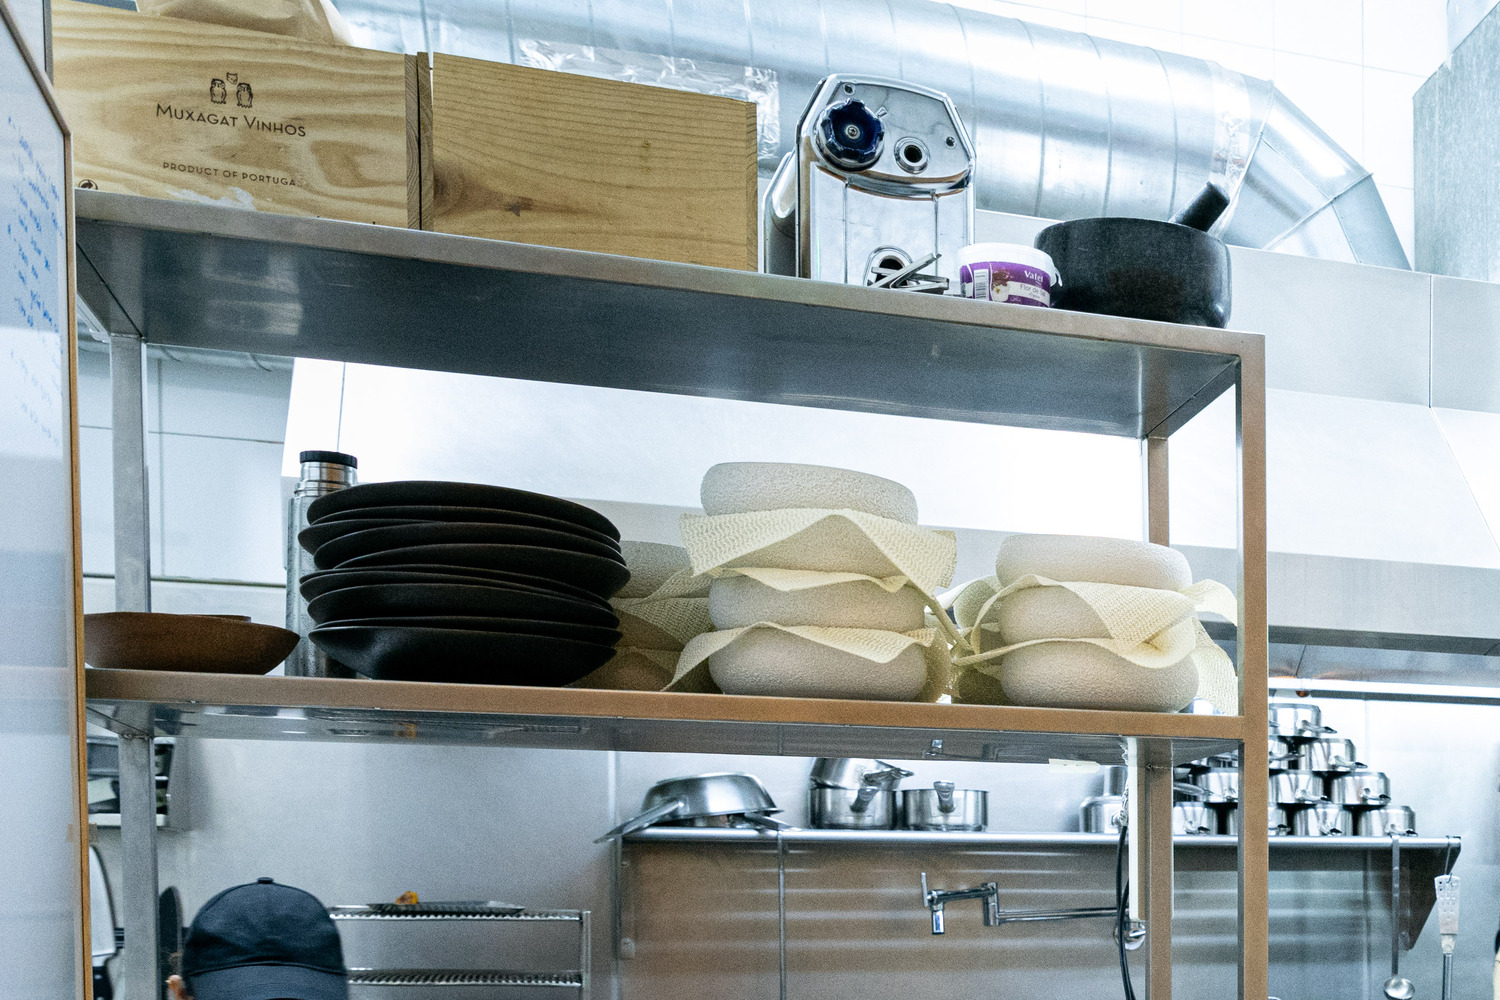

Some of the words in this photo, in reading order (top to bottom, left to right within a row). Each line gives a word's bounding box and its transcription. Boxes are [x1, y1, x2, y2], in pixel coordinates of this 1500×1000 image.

[156, 103, 239, 128] MUXAGAT
[243, 115, 307, 137] VINHOS
[163, 161, 219, 176] PRODUCT
[222, 170, 238, 179] OF
[242, 172, 302, 187] PORTUGA
